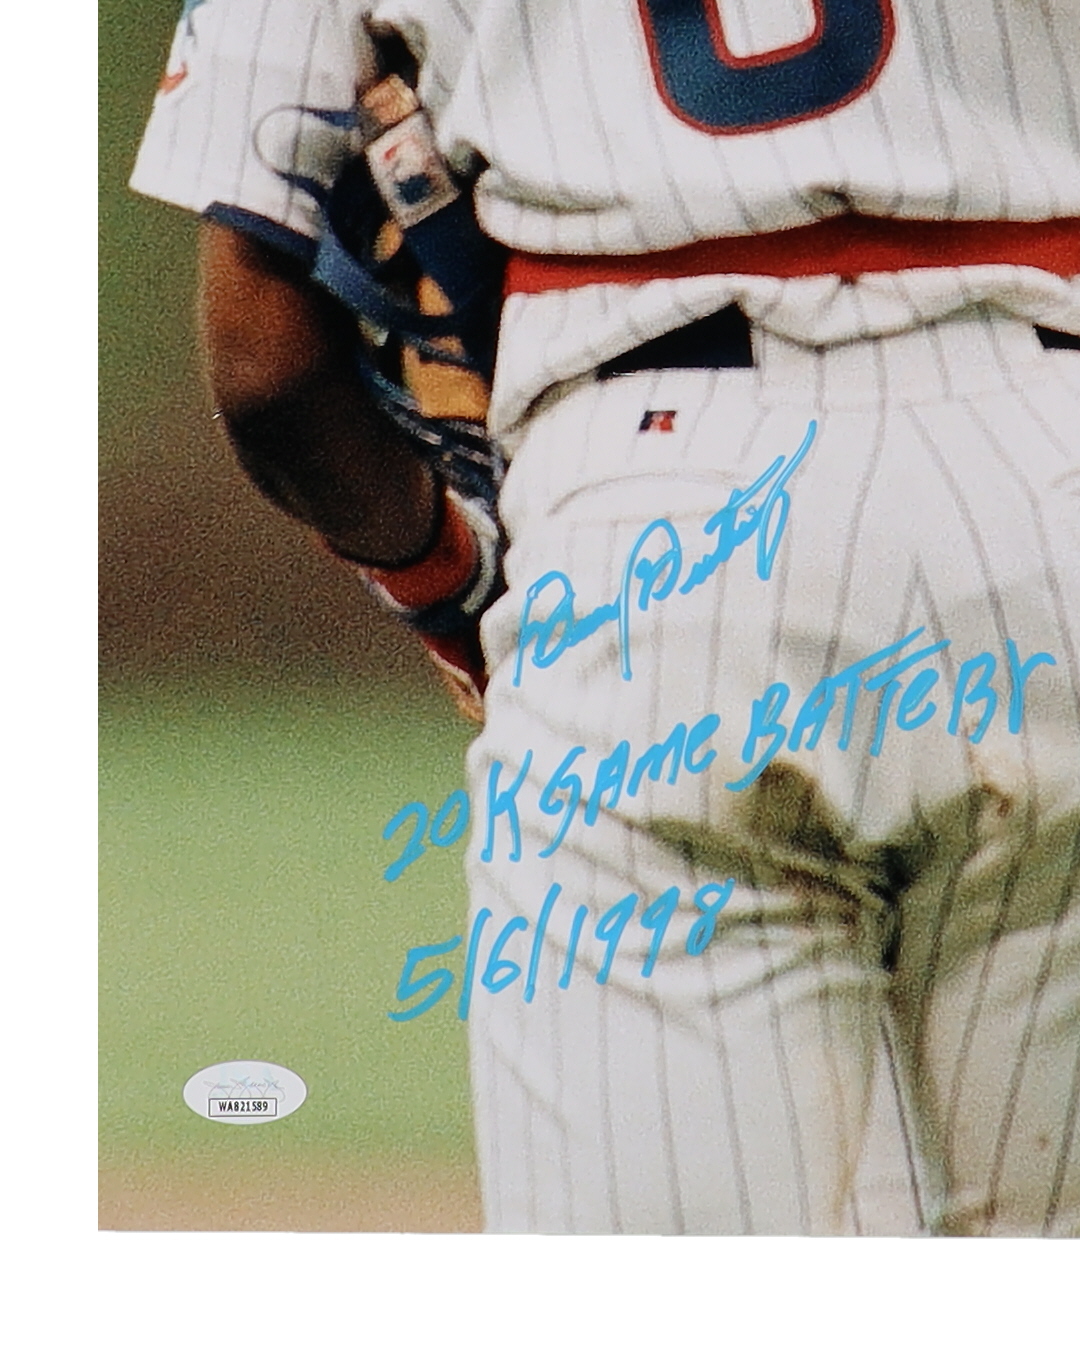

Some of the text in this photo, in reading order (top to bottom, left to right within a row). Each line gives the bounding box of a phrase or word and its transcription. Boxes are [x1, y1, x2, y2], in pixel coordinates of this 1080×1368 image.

[383, 789, 470, 882] 20
[480, 750, 533, 863] K
[387, 878, 736, 1022] 5/6/1998
[218, 1101, 268, 1112] WA821589
